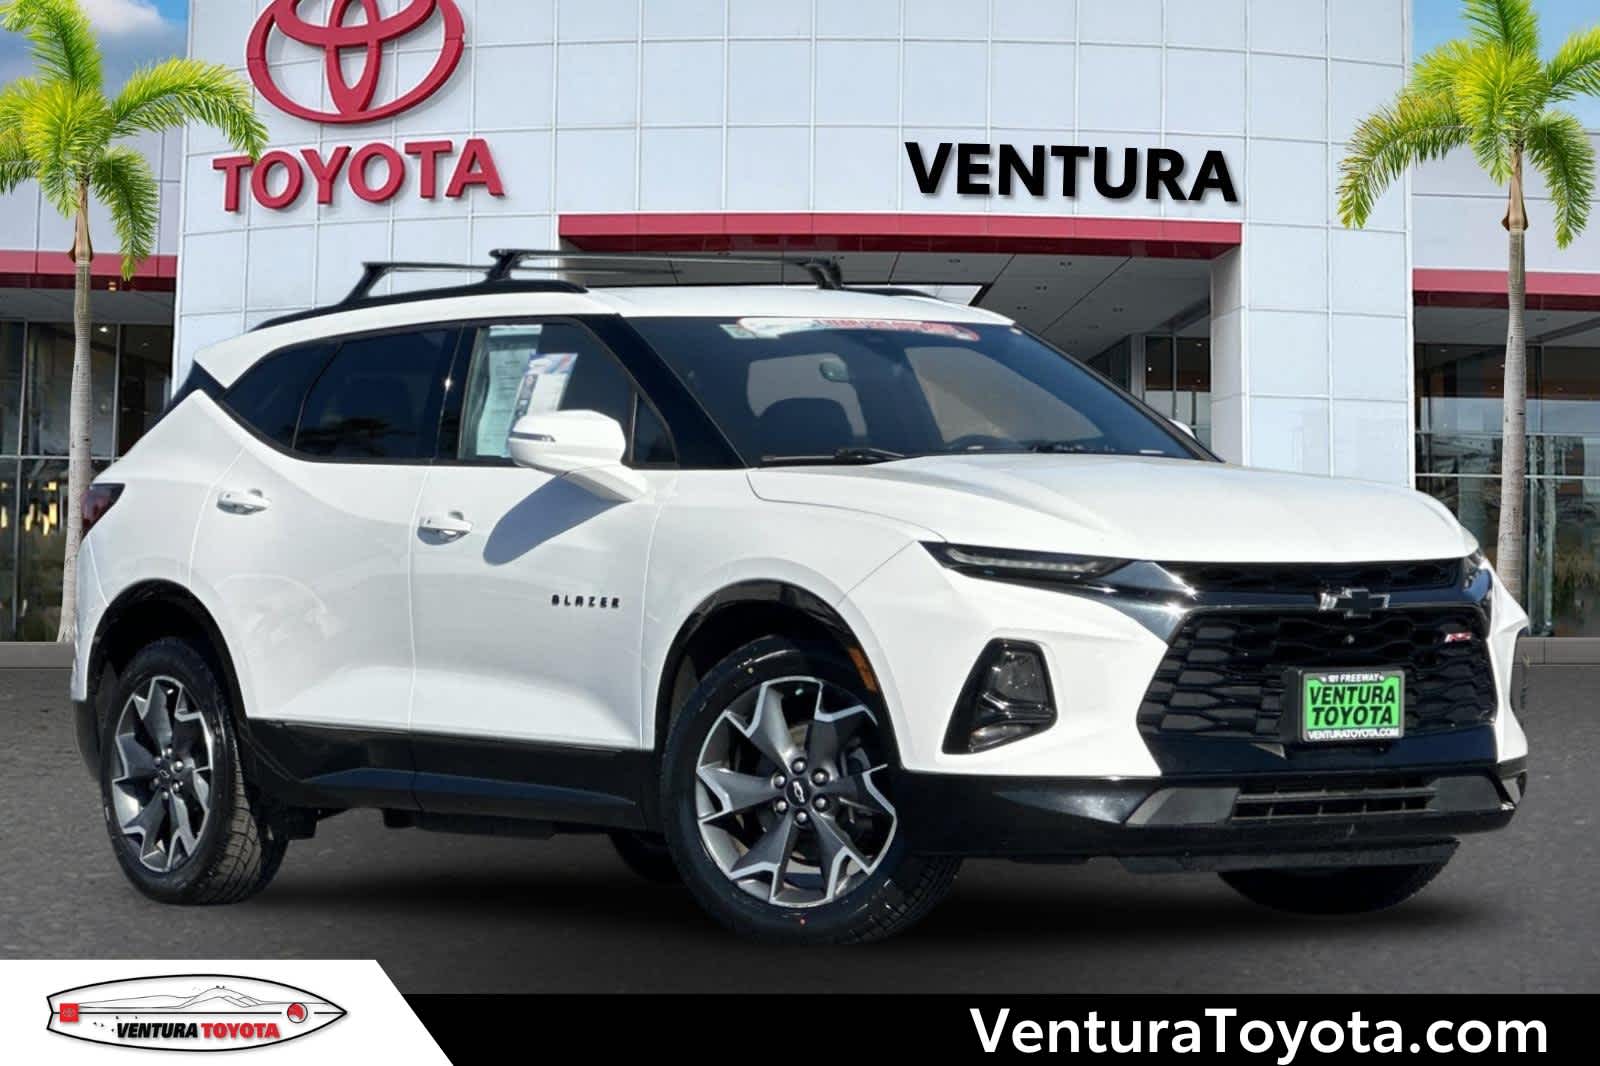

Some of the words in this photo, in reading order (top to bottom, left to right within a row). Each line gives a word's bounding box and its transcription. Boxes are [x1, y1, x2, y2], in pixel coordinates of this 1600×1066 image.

[213, 138, 505, 212] TOYOTA
[904, 141, 1238, 203] VENTURA
[552, 594, 620, 609] BLAZER
[1341, 673, 1379, 682] FREEWAY
[1310, 685, 1396, 705] VENTURA
[1312, 706, 1393, 726] TOYOTA
[1308, 728, 1399, 740] VENTURATOYOTA.COM
